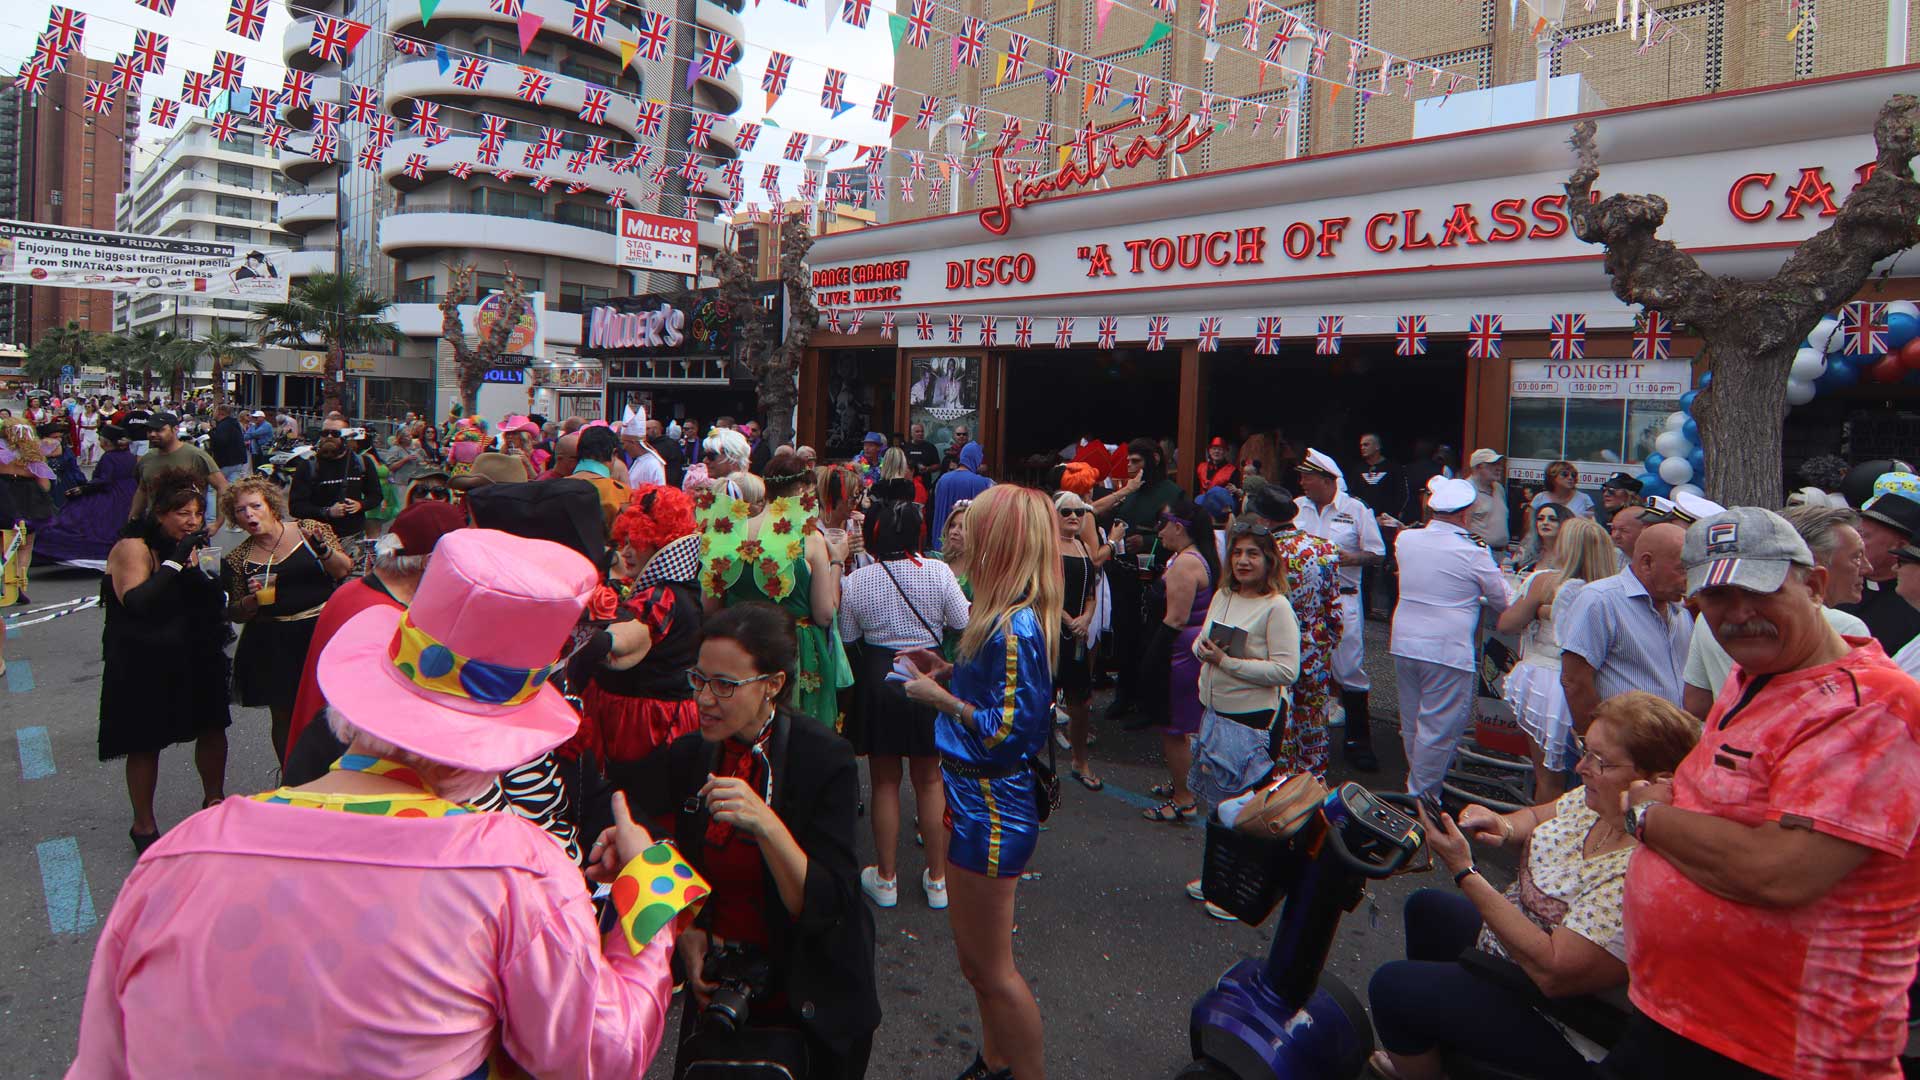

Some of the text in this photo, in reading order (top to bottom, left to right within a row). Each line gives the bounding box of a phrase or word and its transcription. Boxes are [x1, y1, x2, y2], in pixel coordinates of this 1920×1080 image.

[1728, 161, 1877, 223] CA
[0, 225, 47, 237] GIANT
[52, 231, 107, 243] PAELLA
[120, 238, 170, 249] FRIDAY
[182, 244, 209, 253] 3:30
[214, 247, 233, 255] PM
[626, 218, 692, 243] MILLER'S
[626, 240, 652, 250] STAG
[629, 249, 649, 258] HEN
[946, 252, 1036, 291] DISCO
[1124, 226, 1266, 273] TOUCH
[1283, 217, 1351, 260] OF
[18, 241, 231, 270] Enjoying the biggest traditional paella
[682, 253, 692, 263] IT
[28, 257, 57, 267] From
[62, 260, 123, 272] SINATRA'S
[137, 266, 168, 275] touch
[171, 269, 181, 277] of
[185, 270, 213, 279] class
[812, 260, 910, 288] DANCE CABARET
[817, 286, 901, 306] LIVE MUSIC
[589, 303, 685, 349] MILLER'S
[1544, 364, 1645, 379] TONIGHT
[1518, 383, 1553, 392] 09:00 pm
[1575, 383, 1612, 393] 10:00 pm
[1636, 384, 1675, 394] 11:00 pm
[1513, 470, 1535, 479] 12:00
